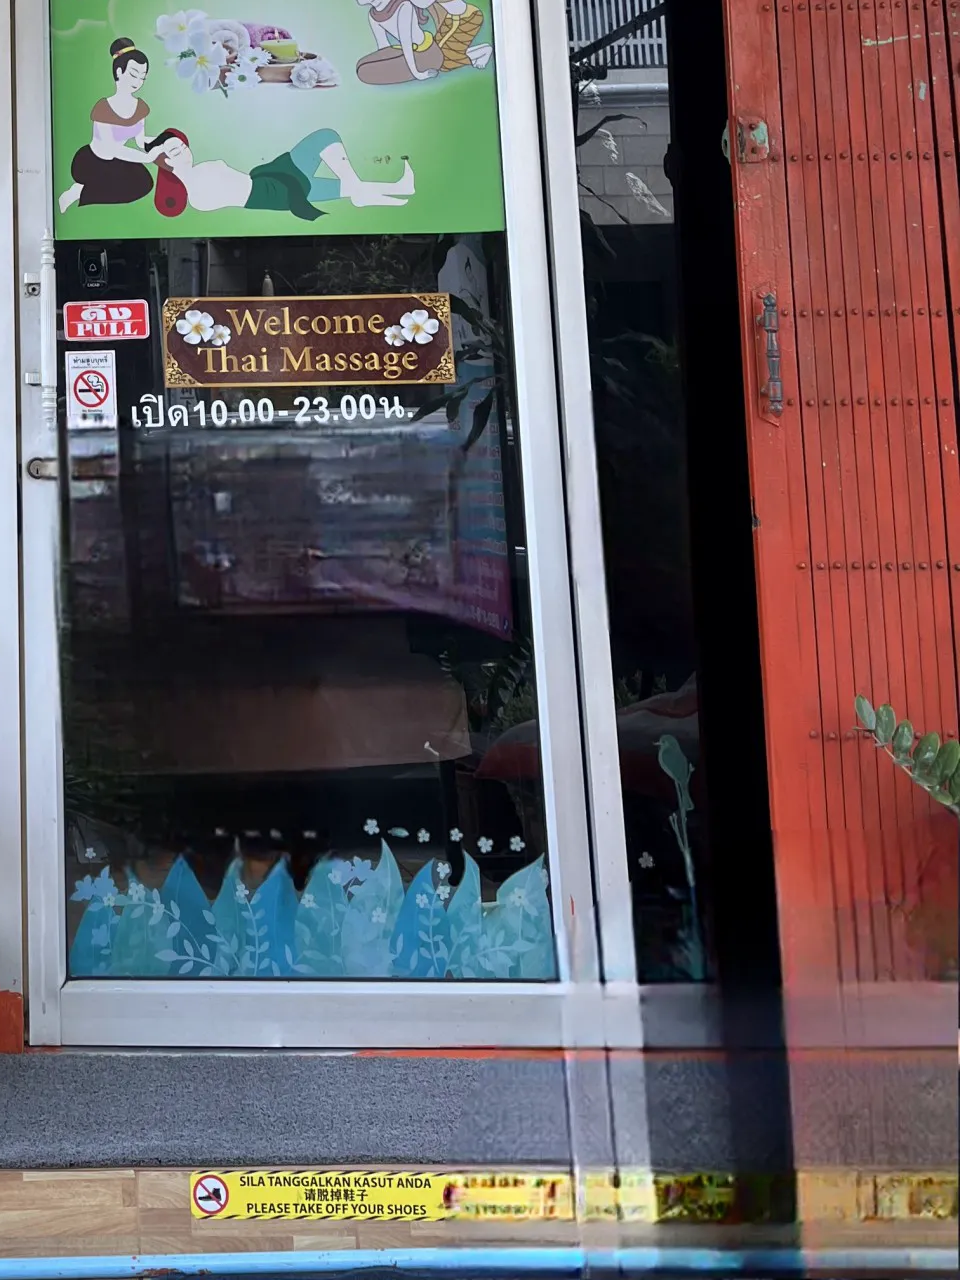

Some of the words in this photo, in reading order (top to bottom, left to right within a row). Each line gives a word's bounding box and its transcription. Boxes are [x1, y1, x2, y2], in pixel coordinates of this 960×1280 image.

[80, 304, 132, 321] ดึง
[76, 321, 138, 337] PULL
[226, 306, 386, 336] Welcome
[197, 346, 268, 374] Thai
[279, 345, 419, 380] Massage
[239, 1176, 265, 1187] SILA
[267, 1176, 351, 1188] TANGGALKAN
[354, 1177, 394, 1188] KASUT
[396, 1177, 431, 1189] ANDA
[303, 1188, 369, 1202] 请脱掉鞋子
[246, 1203, 291, 1214] PLEASE
[292, 1203, 324, 1214] TAKE
[325, 1203, 352, 1215] OFF
[353, 1203, 384, 1215] YOUR
[386, 1204, 427, 1215] SHOES
